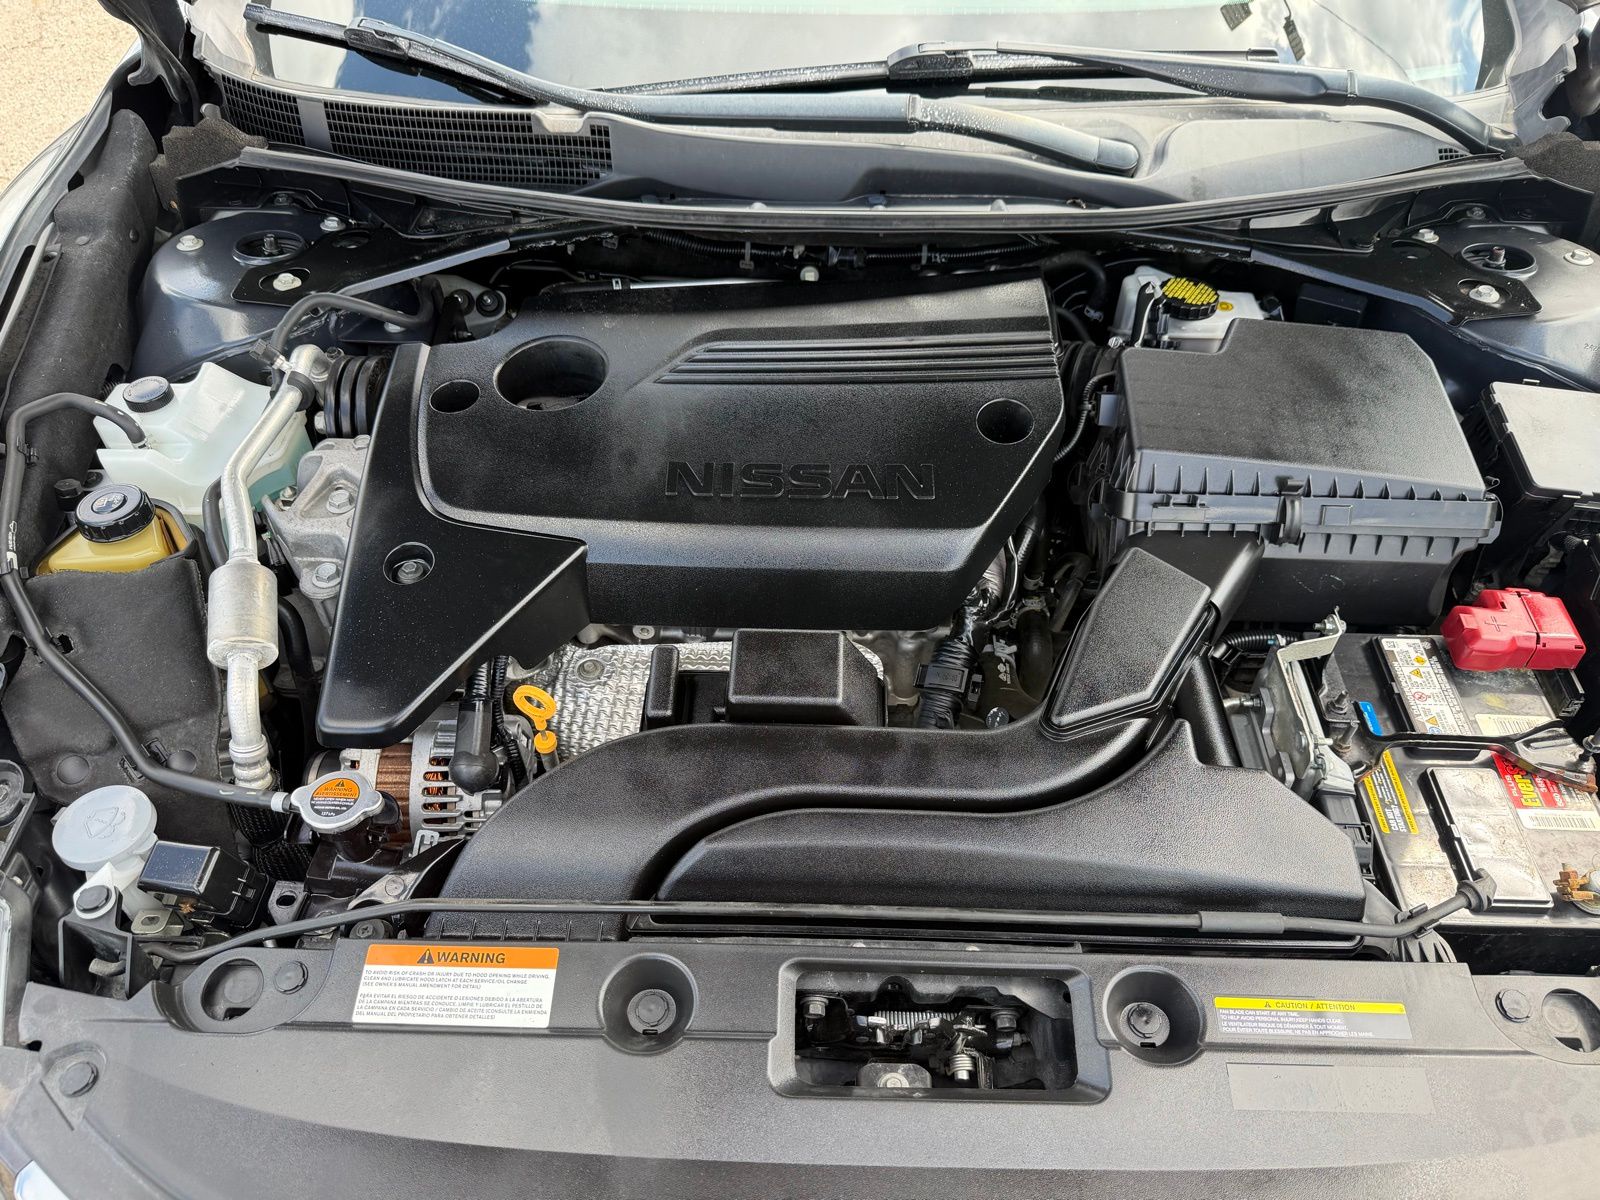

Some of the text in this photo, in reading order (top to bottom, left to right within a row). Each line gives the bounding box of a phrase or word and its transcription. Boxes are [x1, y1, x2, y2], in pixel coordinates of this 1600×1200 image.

[665, 461, 936, 500] NISSAN
[1505, 775, 1519, 797] PLUS
[1385, 808, 1398, 830] CAR NOT
[1391, 804, 1407, 832] STARTING?
[437, 952, 506, 963] WARNING
[1316, 1003, 1355, 1011] ATTENTION
